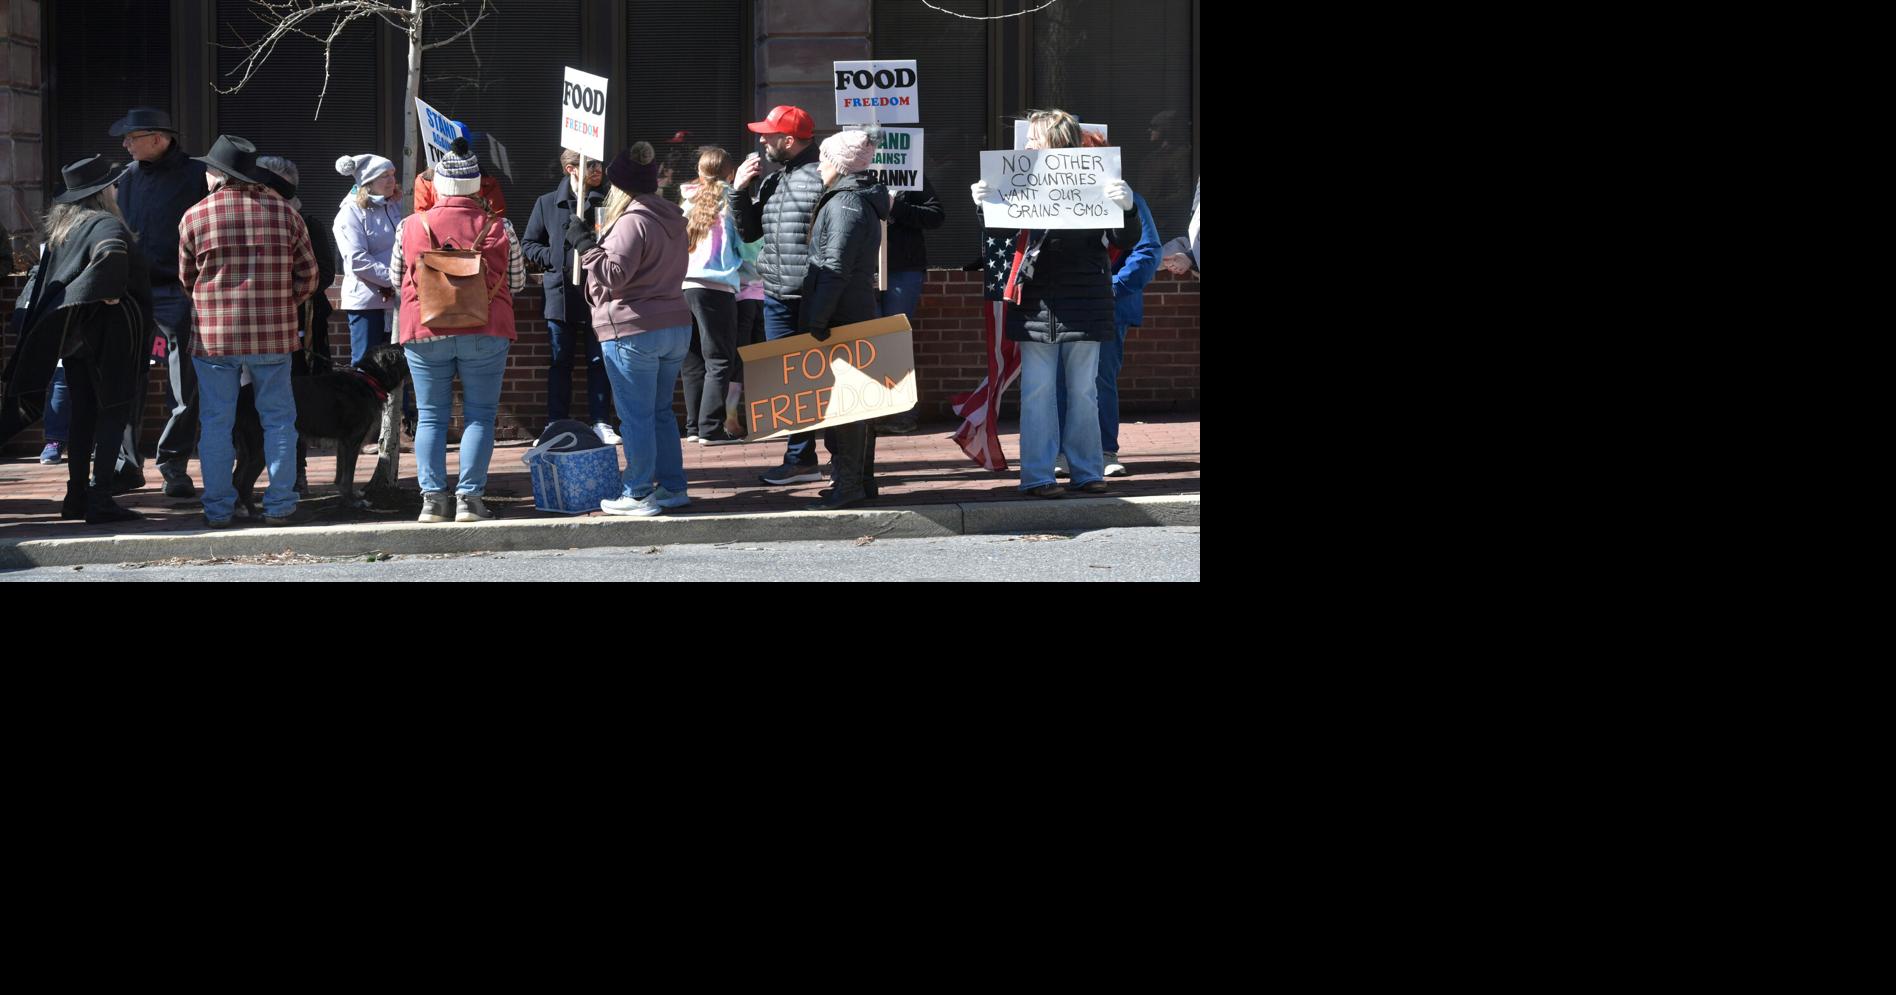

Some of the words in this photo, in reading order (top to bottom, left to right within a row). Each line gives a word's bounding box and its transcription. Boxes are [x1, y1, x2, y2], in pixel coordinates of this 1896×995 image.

[836, 68, 916, 90] FOOD
[563, 80, 605, 116] FOOD
[843, 96, 910, 107] FREEDOM
[425, 107, 457, 140] STAND
[565, 117, 599, 138] FREEDOM
[878, 132, 910, 150] AND
[871, 152, 907, 165] AINST
[1002, 154, 1031, 174] NO
[1045, 153, 1104, 172] OTHER
[866, 169, 918, 186] RANNY
[1010, 172, 1097, 187] COUNTRIES
[998, 188, 1038, 201] WANT
[1048, 188, 1081, 201] OUR
[1007, 203, 1060, 218] GRAINS
[782, 339, 877, 385] FOOD
[750, 369, 917, 433] FREEDOM
